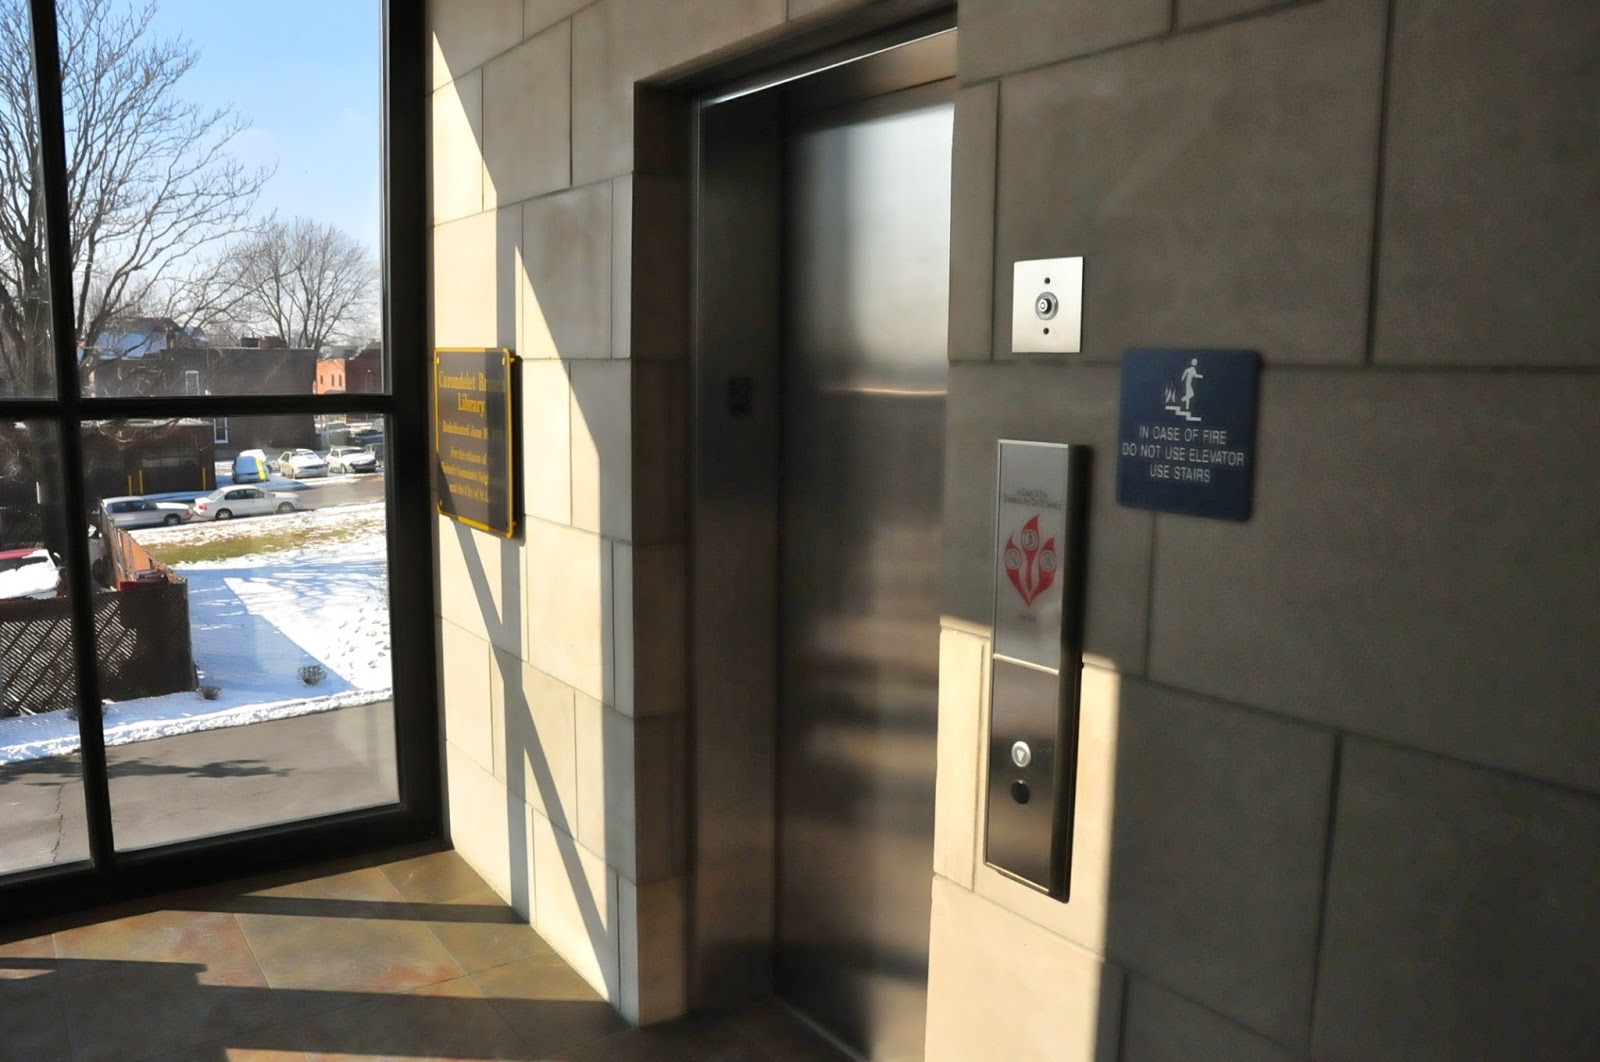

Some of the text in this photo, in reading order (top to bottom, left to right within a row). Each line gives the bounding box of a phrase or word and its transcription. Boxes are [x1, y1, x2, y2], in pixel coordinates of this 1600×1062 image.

[458, 392, 486, 418] Library
[1139, 425, 1227, 445] IN CASE OF FIRE
[1122, 442, 1245, 467] DO NOT USE ELEVATOR
[1150, 464, 1212, 483] USE STAIRS
